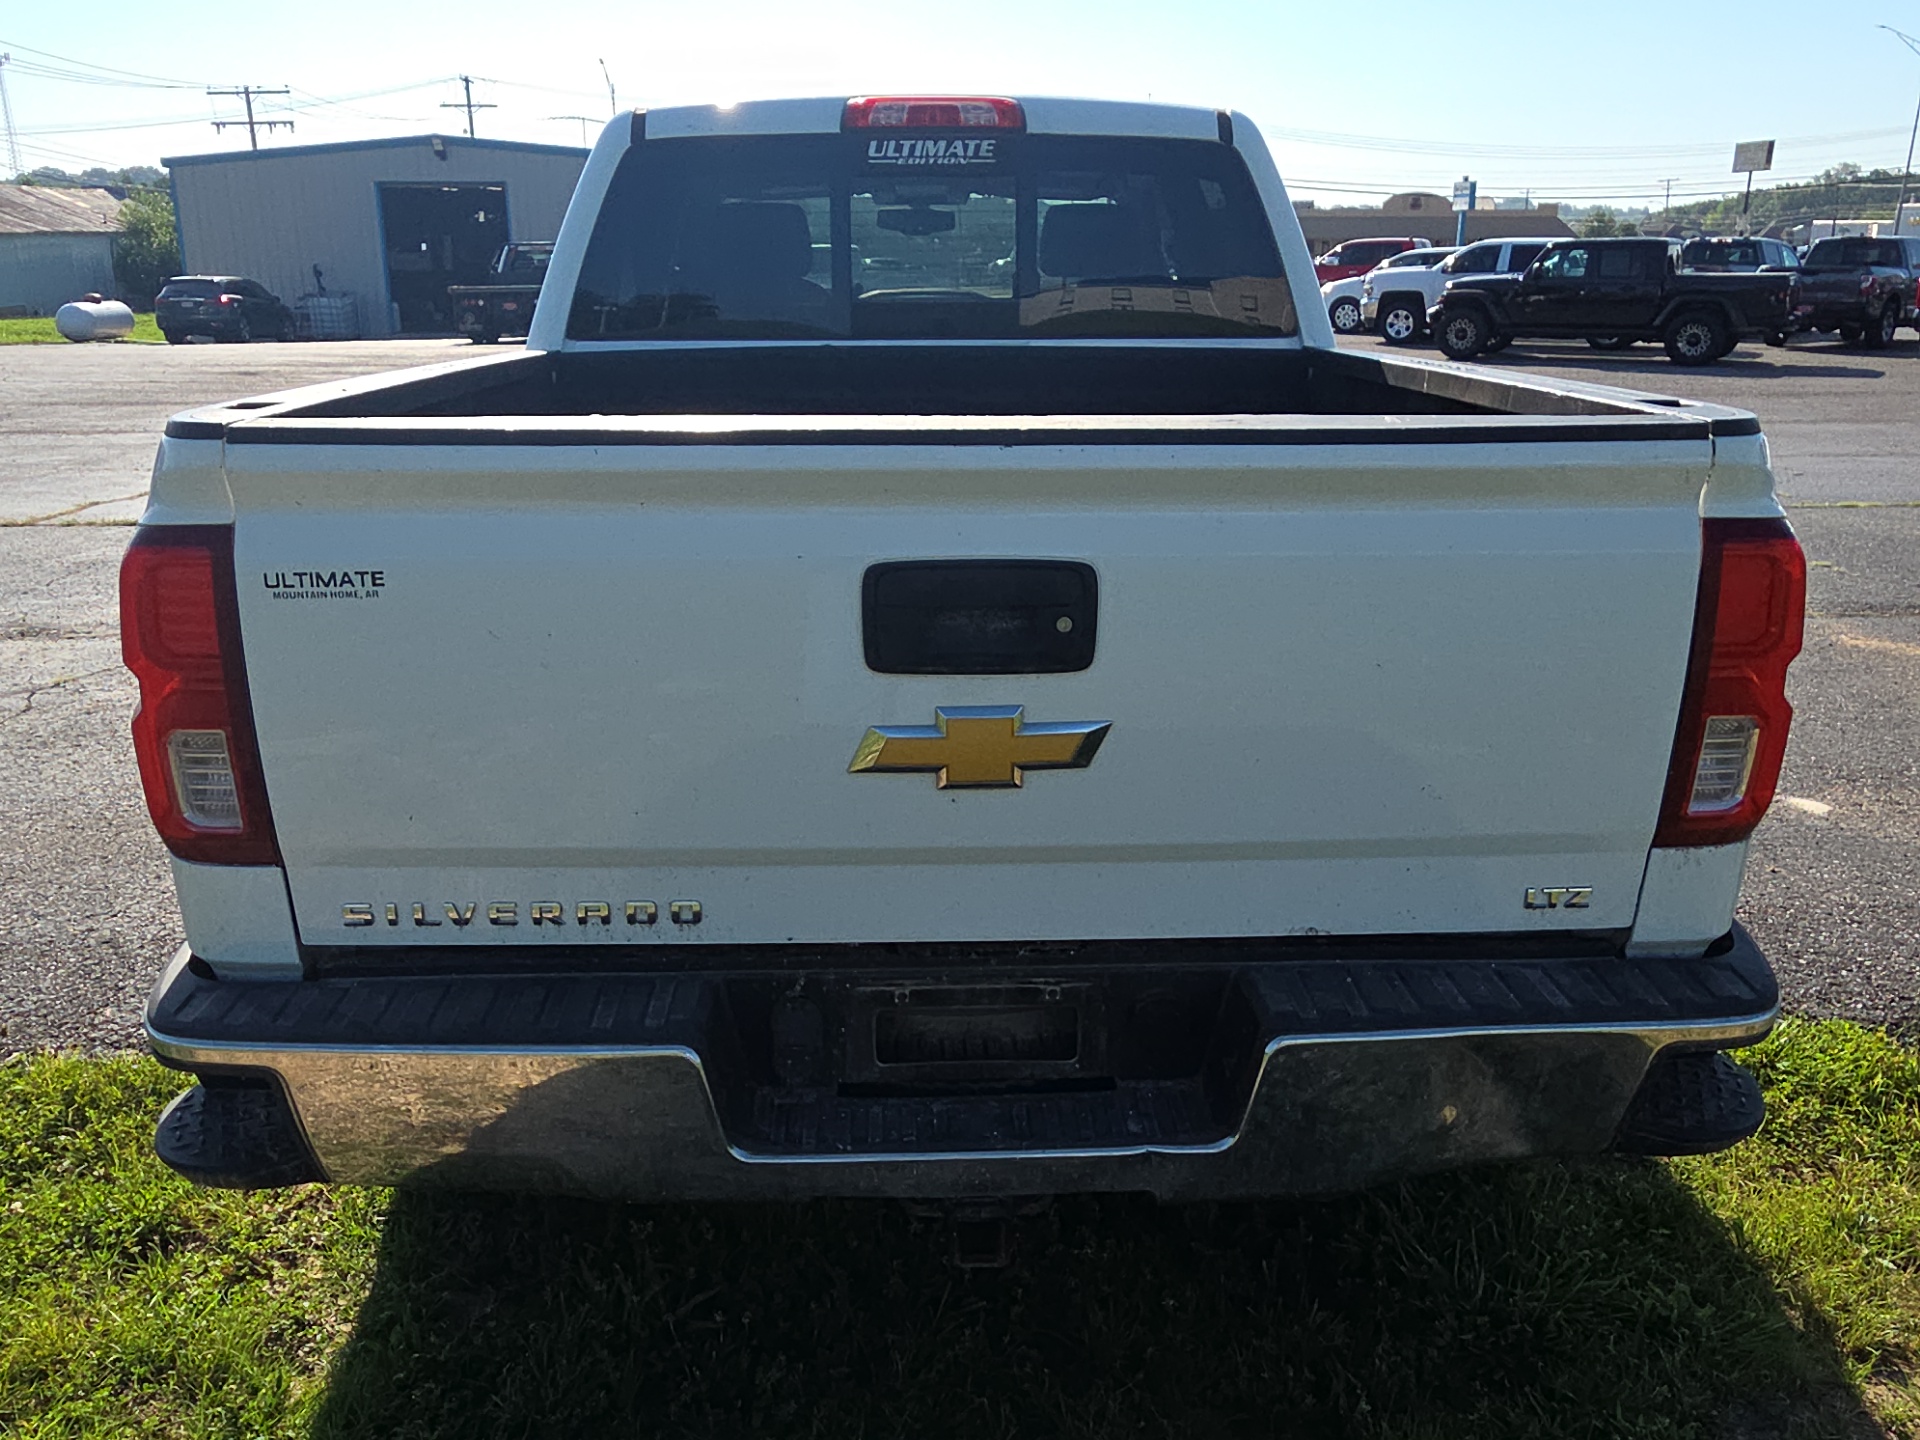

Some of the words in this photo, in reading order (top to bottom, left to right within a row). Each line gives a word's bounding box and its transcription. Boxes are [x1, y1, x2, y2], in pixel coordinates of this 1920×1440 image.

[868, 139, 996, 157] ULTIMATE
[897, 157, 970, 165] EDITION
[263, 571, 385, 588] ULTIMATE
[273, 591, 327, 600] MOUNTAIN
[330, 590, 363, 600] HOME,
[366, 590, 379, 599] AR
[1524, 886, 1592, 909] LTZ
[342, 901, 703, 927] SILVERADO
